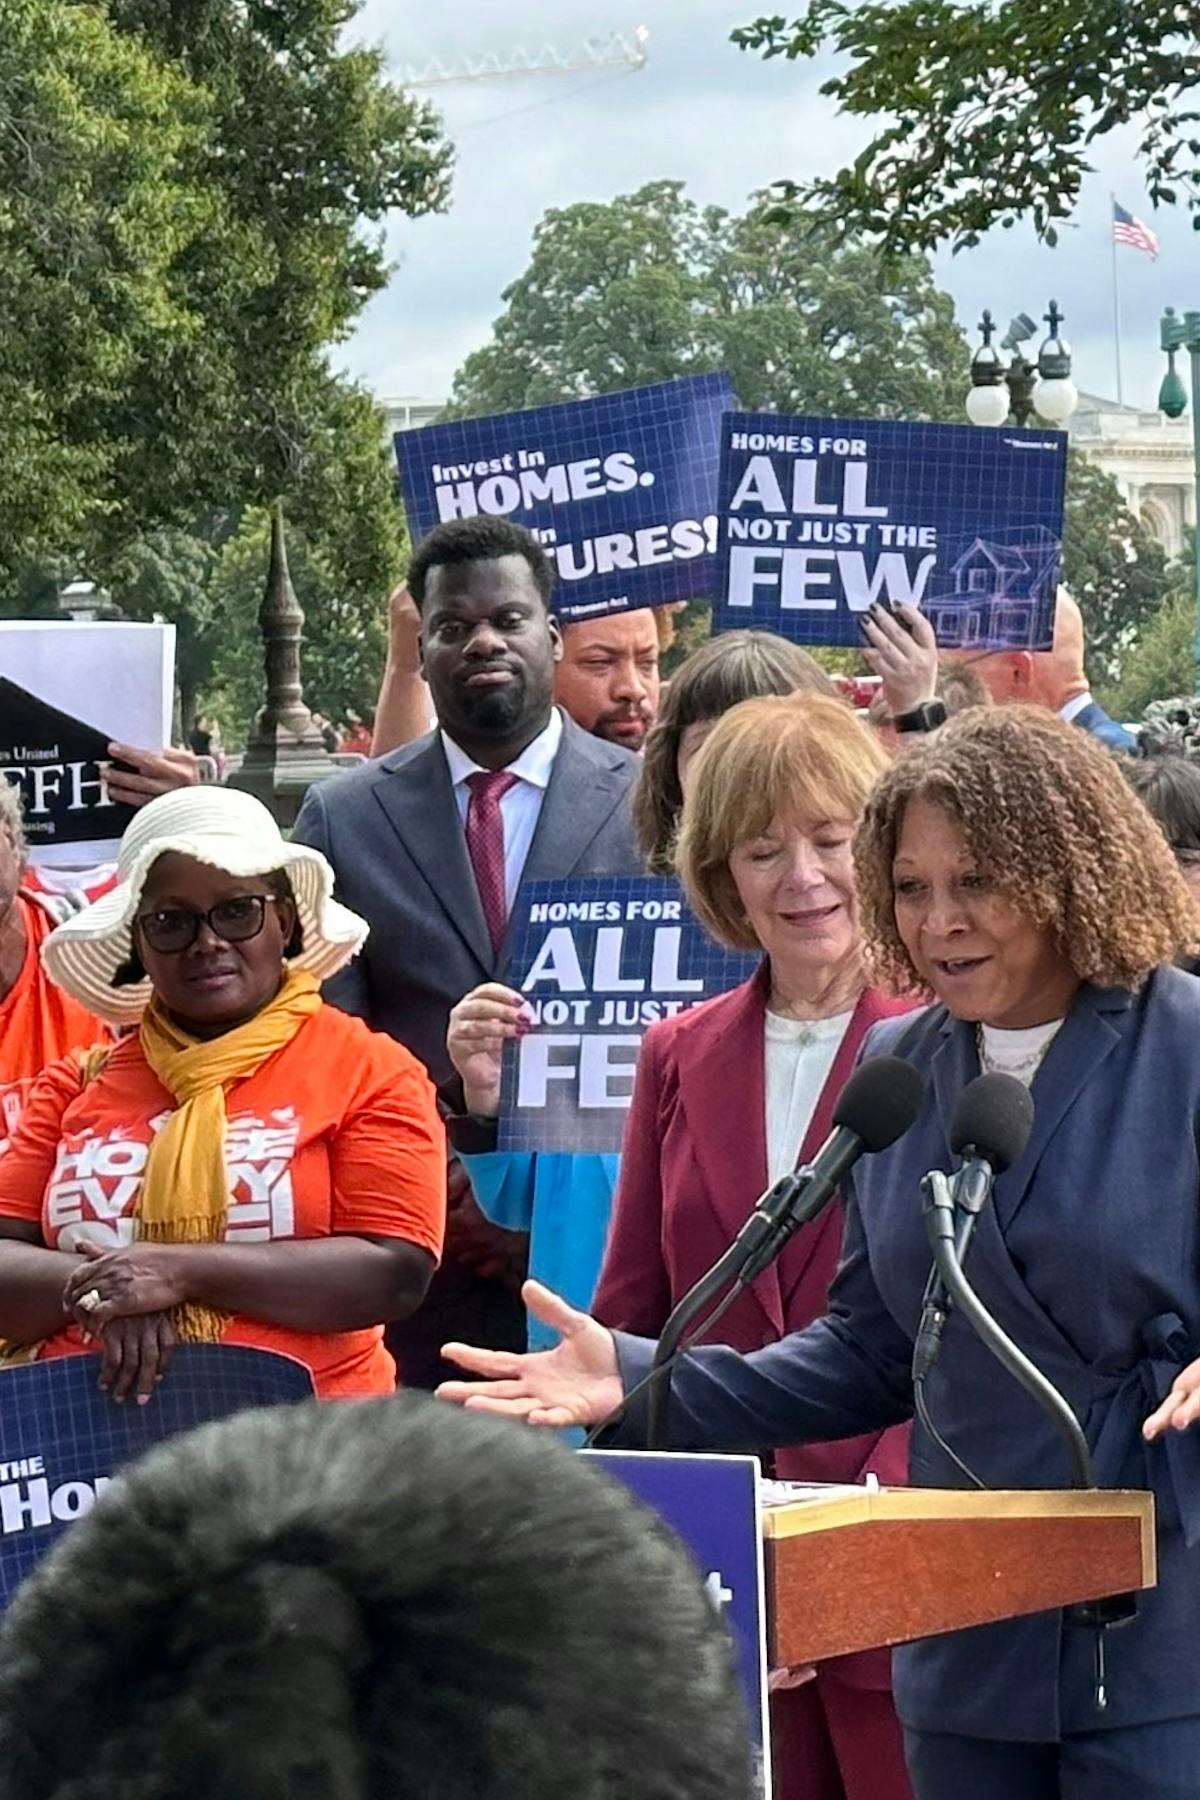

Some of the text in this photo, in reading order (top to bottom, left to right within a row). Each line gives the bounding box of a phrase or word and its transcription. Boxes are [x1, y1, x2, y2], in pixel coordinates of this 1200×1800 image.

[731, 433, 867, 456] HOMES FOR
[432, 450, 545, 482] Invest In
[435, 453, 655, 523] HOMES.
[729, 455, 888, 518] ALL
[545, 515, 718, 581] URES!
[728, 517, 937, 548] NOT JUST THE
[728, 545, 937, 612] FEW
[530, 901, 681, 923] HOMES FOR
[521, 927, 703, 992] ALL
[521, 1000, 682, 1027] NOT JUST
[0, 1455, 45, 1481] THE
